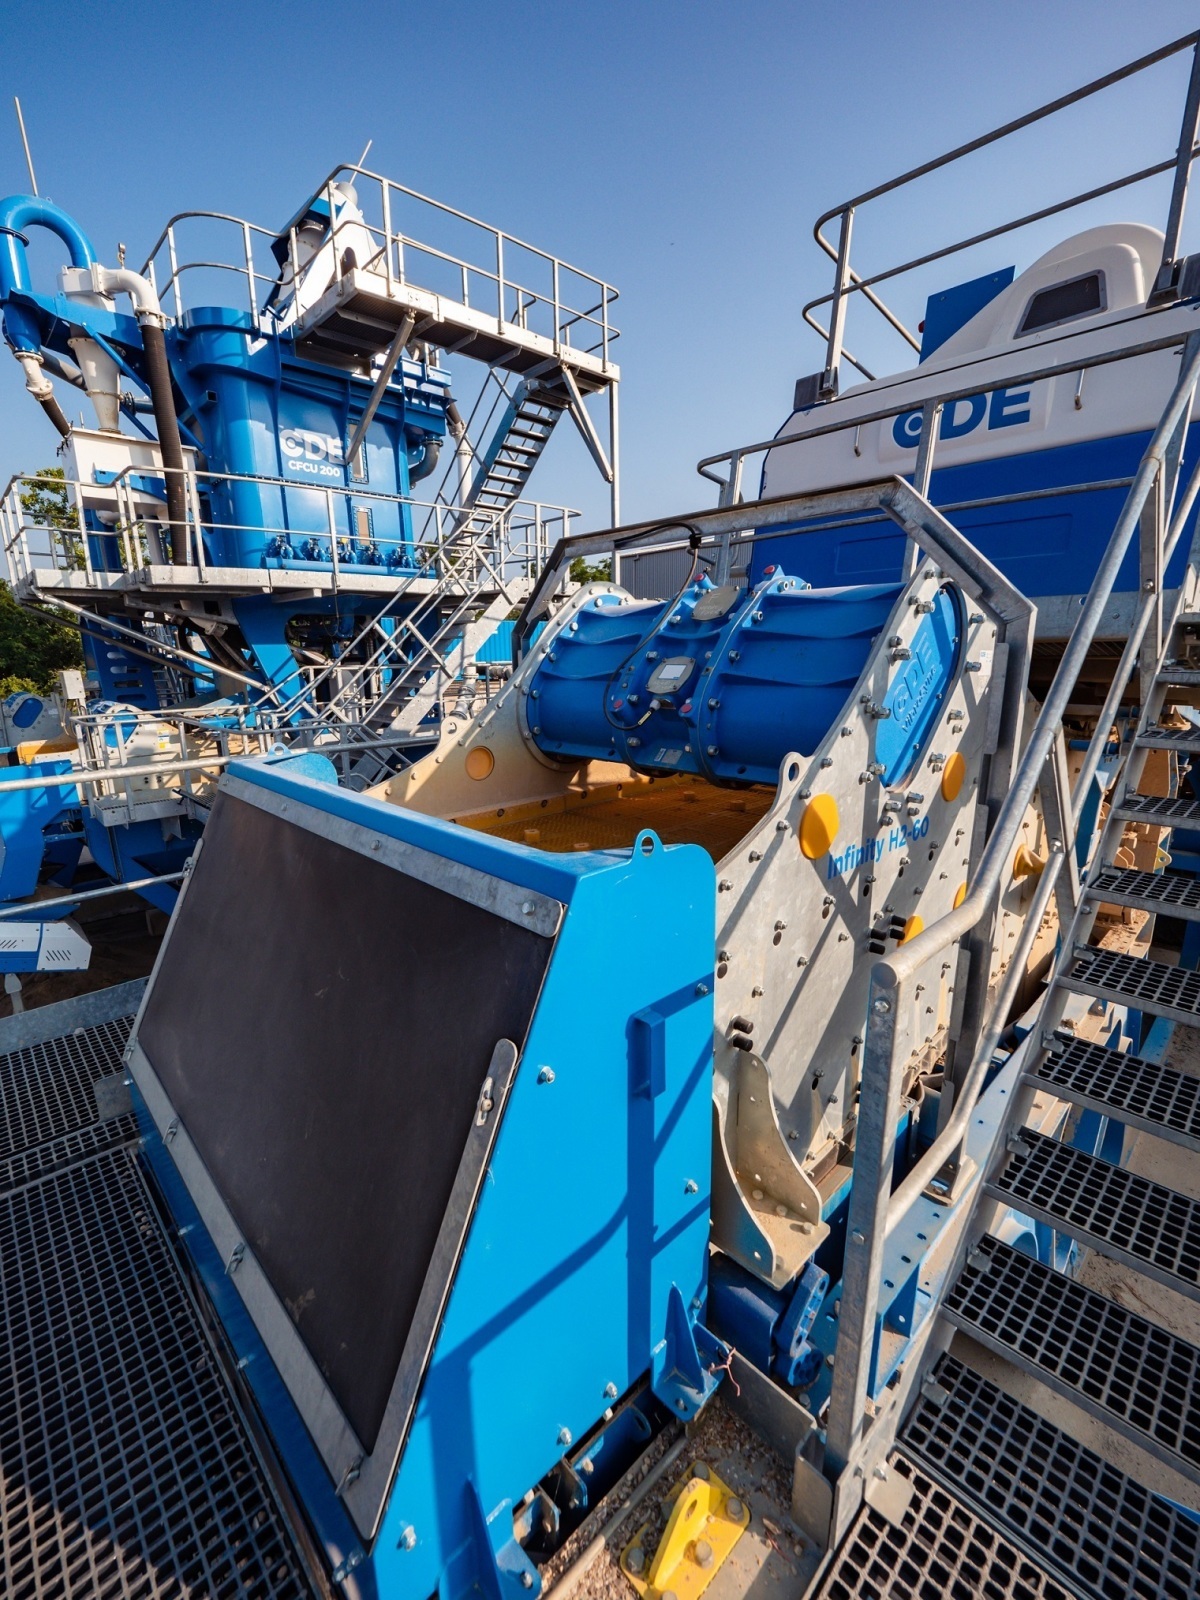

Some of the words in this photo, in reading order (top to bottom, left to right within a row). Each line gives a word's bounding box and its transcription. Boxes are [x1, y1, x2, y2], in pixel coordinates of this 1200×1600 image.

[280, 429, 345, 465] CDE
[288, 460, 318, 473] CFCU
[320, 465, 340, 477] 200
[827, 838, 885, 880] Infinity
[889, 815, 930, 852] H2-60
